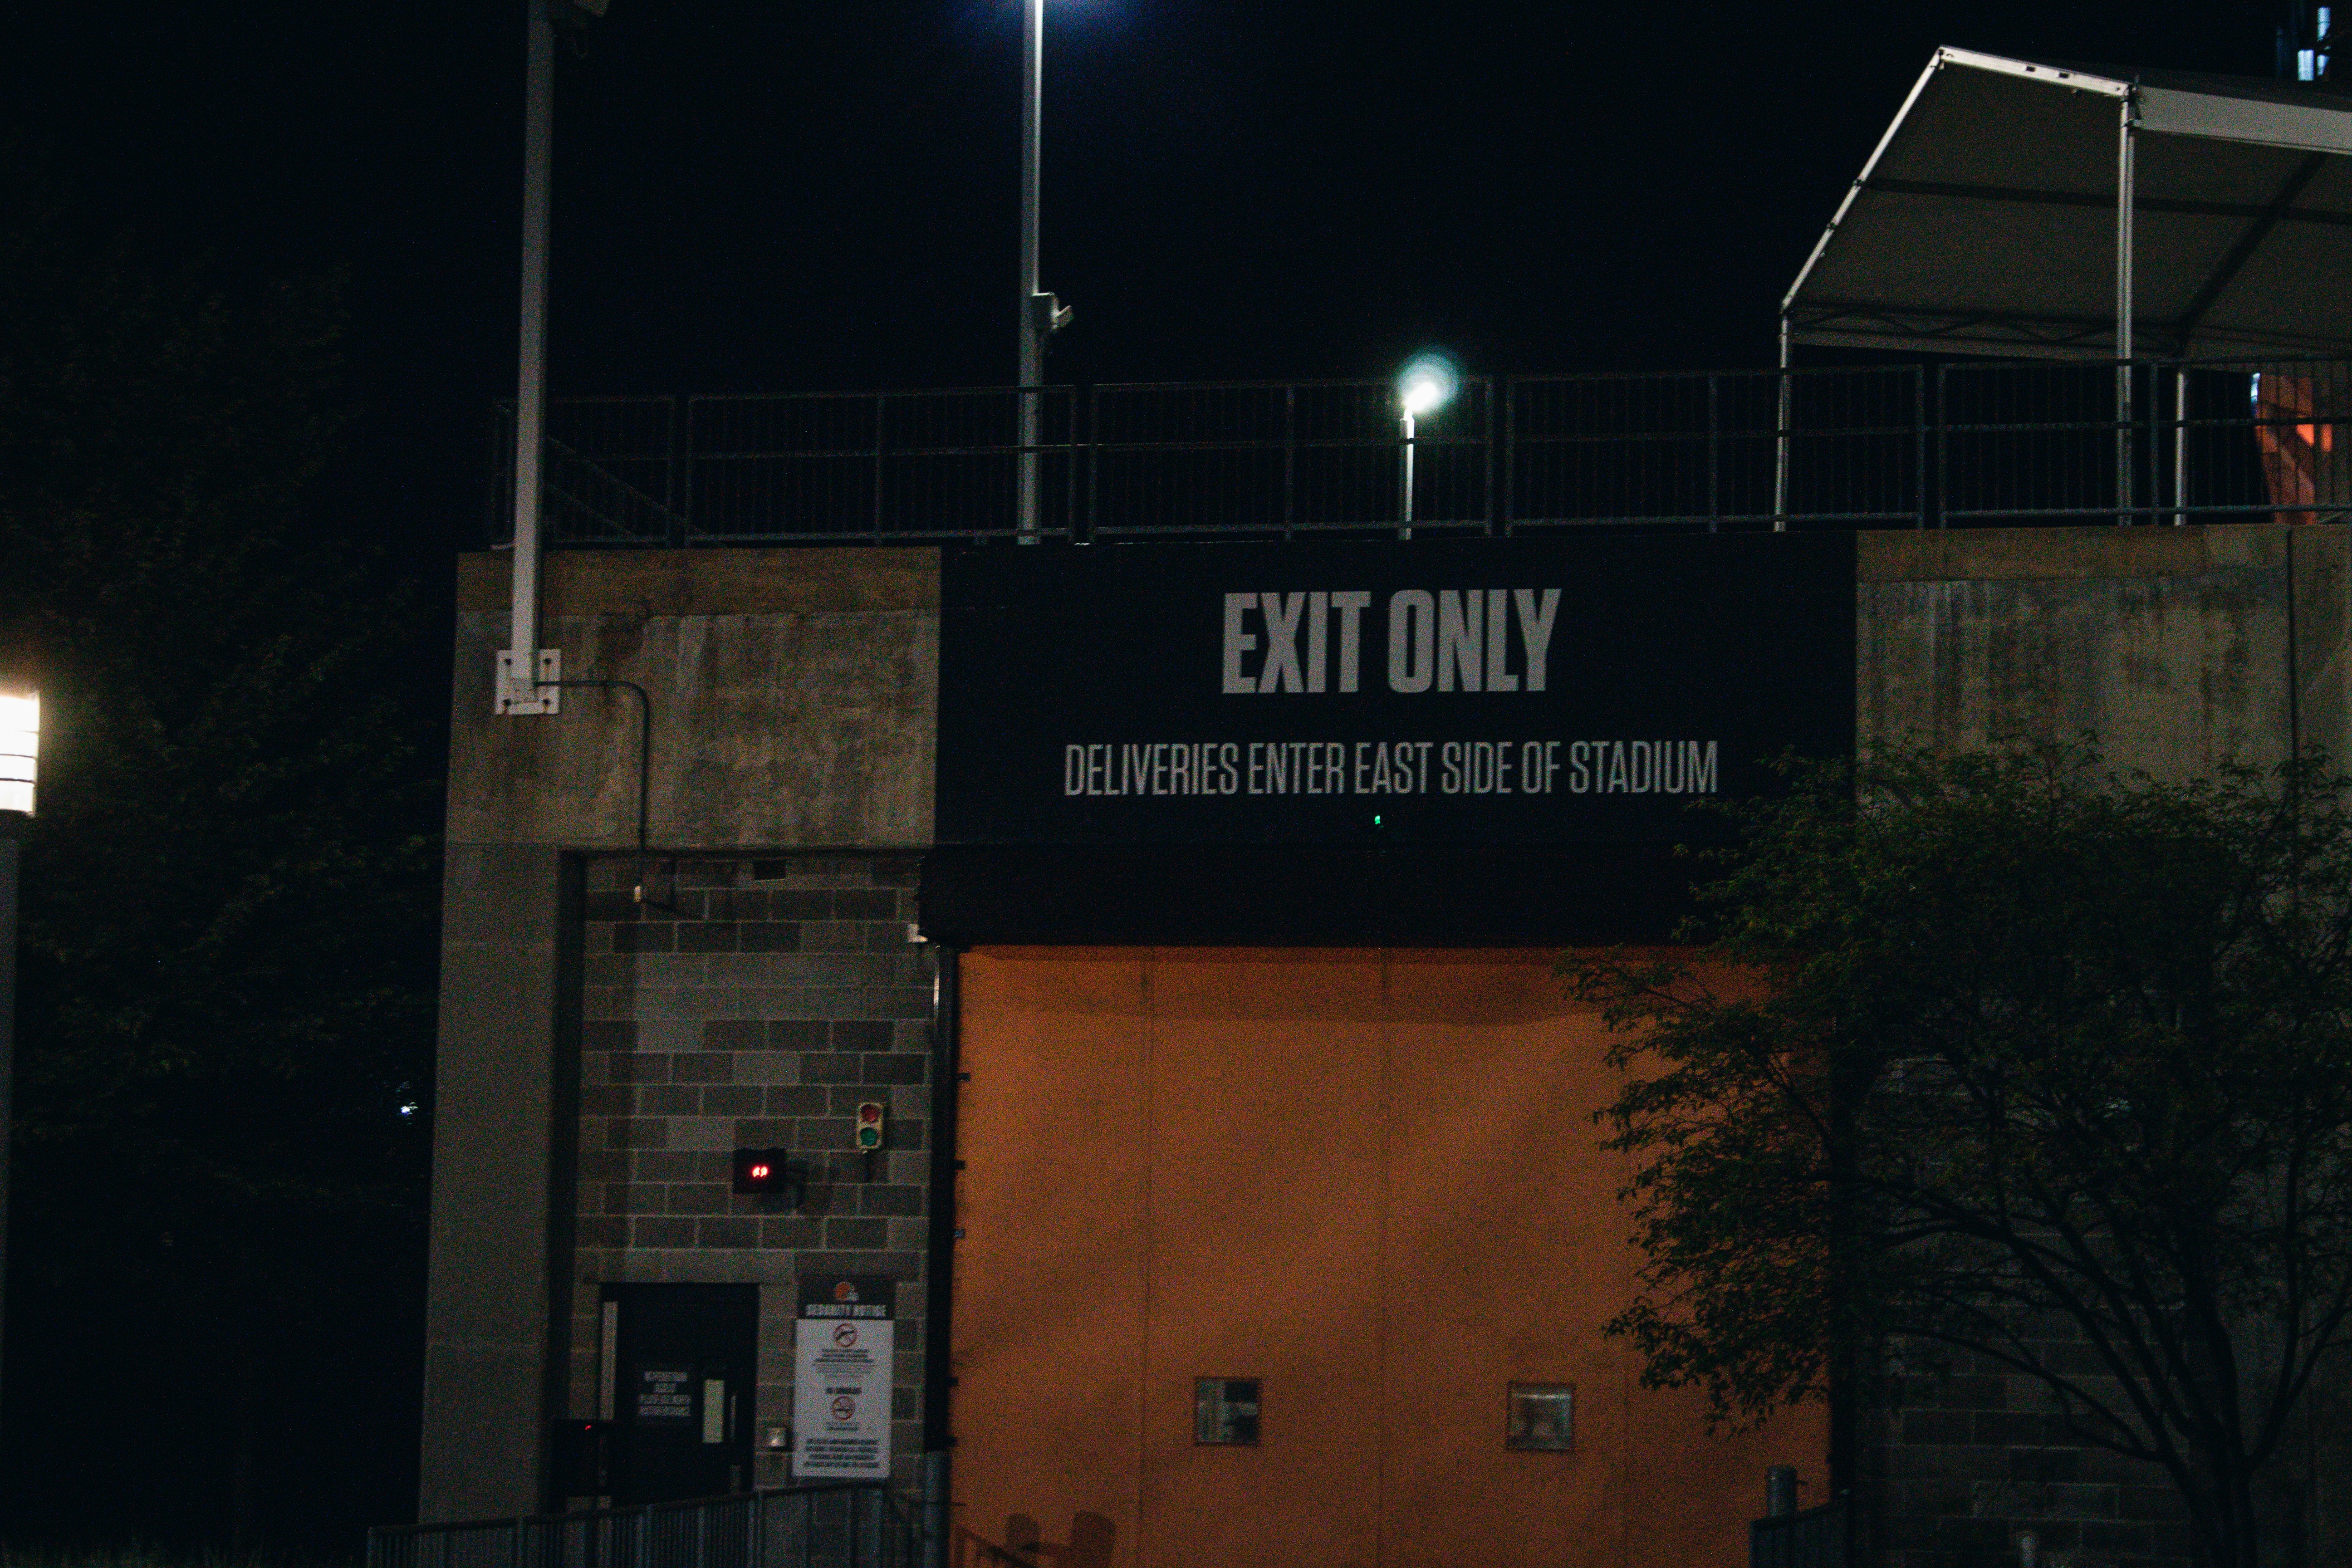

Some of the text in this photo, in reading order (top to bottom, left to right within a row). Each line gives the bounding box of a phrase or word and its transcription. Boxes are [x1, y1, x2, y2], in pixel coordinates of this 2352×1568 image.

[1222, 588, 1562, 694] EXIT ONLY
[1064, 740, 1718, 796] DELIVERIES ENTER EAST SIDE OF STADIUM
